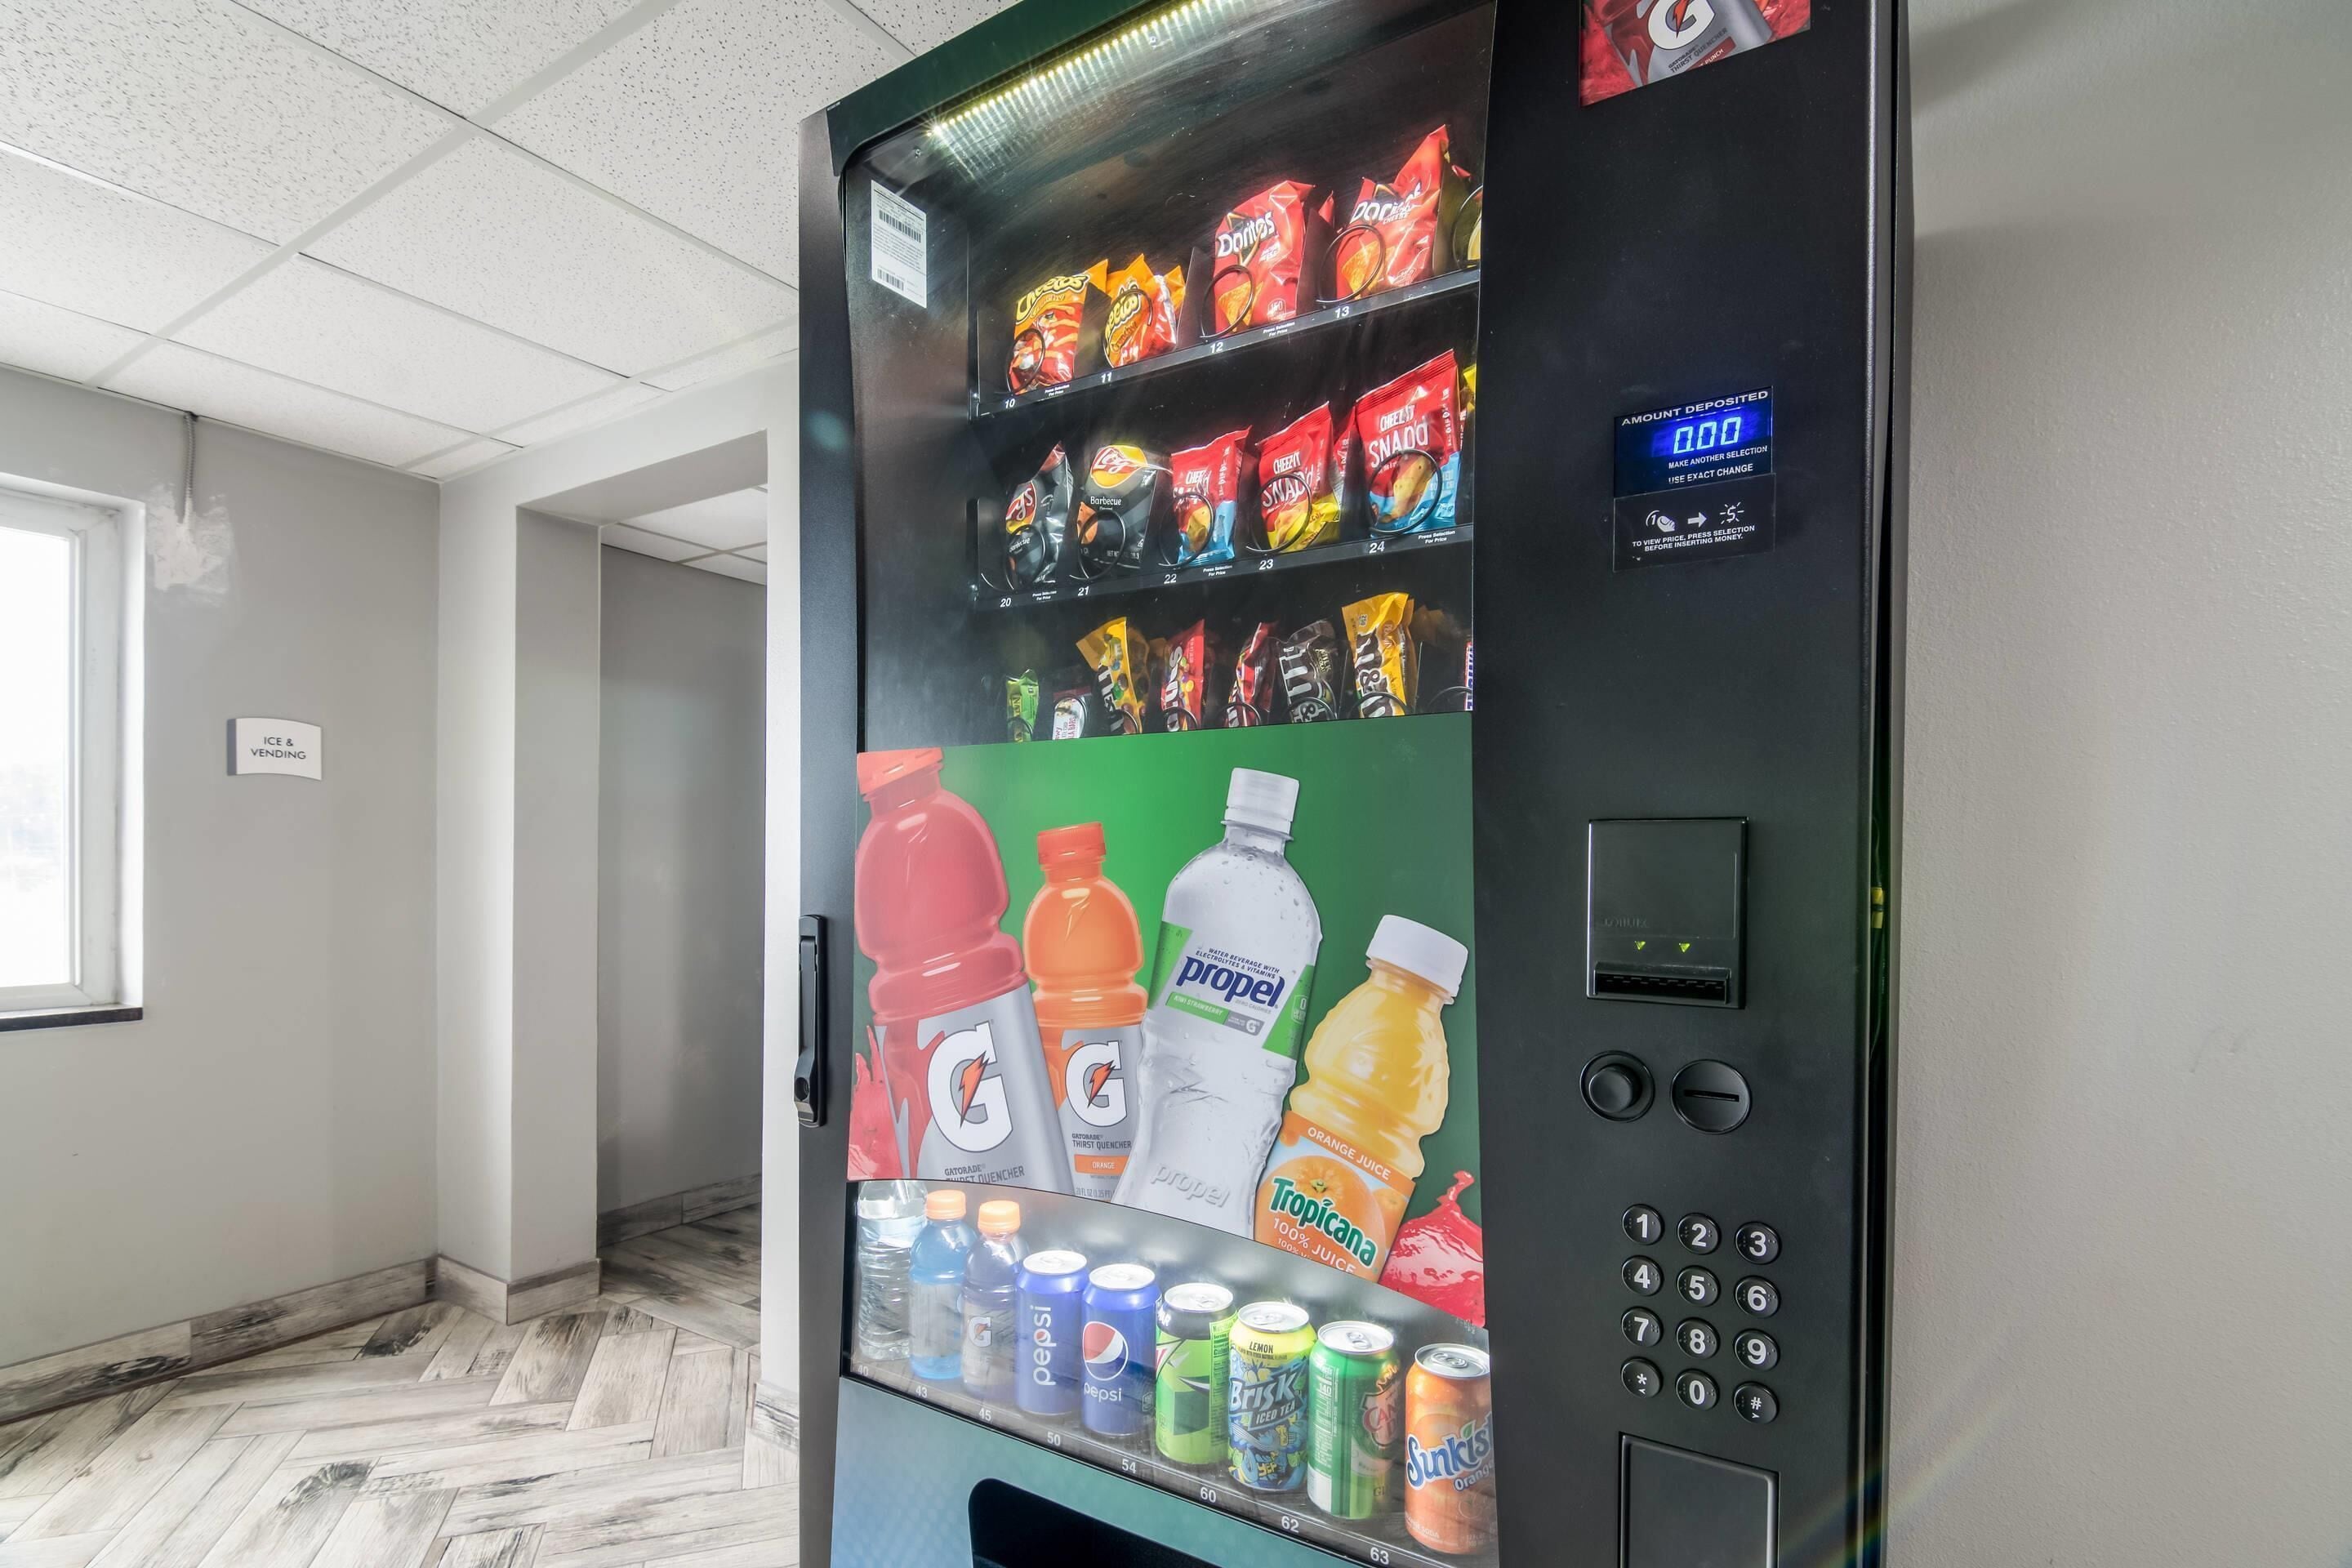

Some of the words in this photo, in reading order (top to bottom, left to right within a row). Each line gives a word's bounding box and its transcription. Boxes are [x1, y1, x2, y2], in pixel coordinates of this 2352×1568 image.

[1670, 55, 1693, 73] THIRST
[1694, 27, 1728, 58] QUENCHER
[1217, 212, 1275, 257] Doritos
[1334, 306, 1350, 318] 13
[1210, 341, 1223, 354] 12
[1101, 372, 1112, 384] 11
[1004, 399, 1016, 409] 10
[1621, 408, 1682, 426] AMOUNT
[1685, 390, 1769, 415] DEPOSITED
[1668, 459, 1689, 470] MAKE
[1690, 452, 1725, 466] ANOTHER
[1726, 445, 1768, 459] SELECTION
[1668, 475, 1685, 484] USE
[1687, 470, 1715, 482] EXACT
[1717, 463, 1753, 477] CHANGE
[1090, 496, 1121, 506] Barbecue
[1643, 537, 1660, 546] VIEW
[1687, 530, 1711, 540] PRESS
[1713, 525, 1755, 537] SELECTION
[1369, 541, 1385, 554] 24
[1644, 542, 1673, 552] BEFORE
[1674, 537, 1713, 548] INSERTING
[1259, 559, 1273, 570] 23
[1164, 573, 1177, 584] 22
[1077, 586, 1089, 596] 21
[1000, 598, 1011, 608] 20
[264, 737, 282, 746] ICE
[286, 738, 293, 746] &
[251, 748, 306, 760] VENDING
[1196, 951, 1239, 969] ELECTROLYTES
[1247, 966, 1276, 979] VITAMINS
[1209, 948, 1229, 959] WATER
[1230, 954, 1262, 969] BEVERAGE
[1263, 964, 1280, 973] WITH
[1176, 956, 1285, 1008] propel
[1187, 999, 1223, 1016] STRAWBERRY
[1246, 1019, 1257, 1033] G
[928, 1021, 1013, 1152] G
[1065, 1041, 1128, 1127] G
[1072, 1140, 1094, 1148] THIRST
[1097, 1141, 1132, 1150] QUENCHER
[1307, 1127, 1356, 1160] ORANGE
[1356, 1154, 1391, 1181] JUICE
[945, 1165, 982, 1176] GATORADE
[1092, 1161, 1116, 1169] ORANGE
[979, 1165, 1025, 1183] QUENCHER
[1151, 1165, 1230, 1207] propel
[1270, 1177, 1377, 1267] Tropicana
[1636, 1214, 1648, 1238] 1
[1691, 1223, 1707, 1247] 2
[1749, 1232, 1766, 1256] 3
[1273, 1218, 1310, 1249] 100%
[1312, 1244, 1357, 1274] JUICE
[1633, 1264, 1650, 1289] 4
[1689, 1275, 1705, 1300] 5
[1747, 1285, 1766, 1311] 6
[969, 1316, 991, 1347] G
[1030, 1305, 1056, 1386] pepsi
[1249, 1342, 1273, 1354] LEMON
[1633, 1316, 1649, 1342] 7
[1689, 1329, 1705, 1354] 8
[1747, 1339, 1766, 1365] 9
[858, 1365, 869, 1376] 40
[915, 1387, 928, 1398] 43
[1084, 1382, 1122, 1402] pepsi
[1689, 1379, 1704, 1405] 0
[979, 1409, 991, 1421] 45
[1256, 1410, 1277, 1425] ICED
[1280, 1400, 1295, 1415] TEA
[1047, 1432, 1061, 1446] 50
[1121, 1459, 1137, 1474] 54
[1200, 1488, 1217, 1503] 60
[1281, 1517, 1299, 1533] 62
[1370, 1548, 1389, 1564] 63
